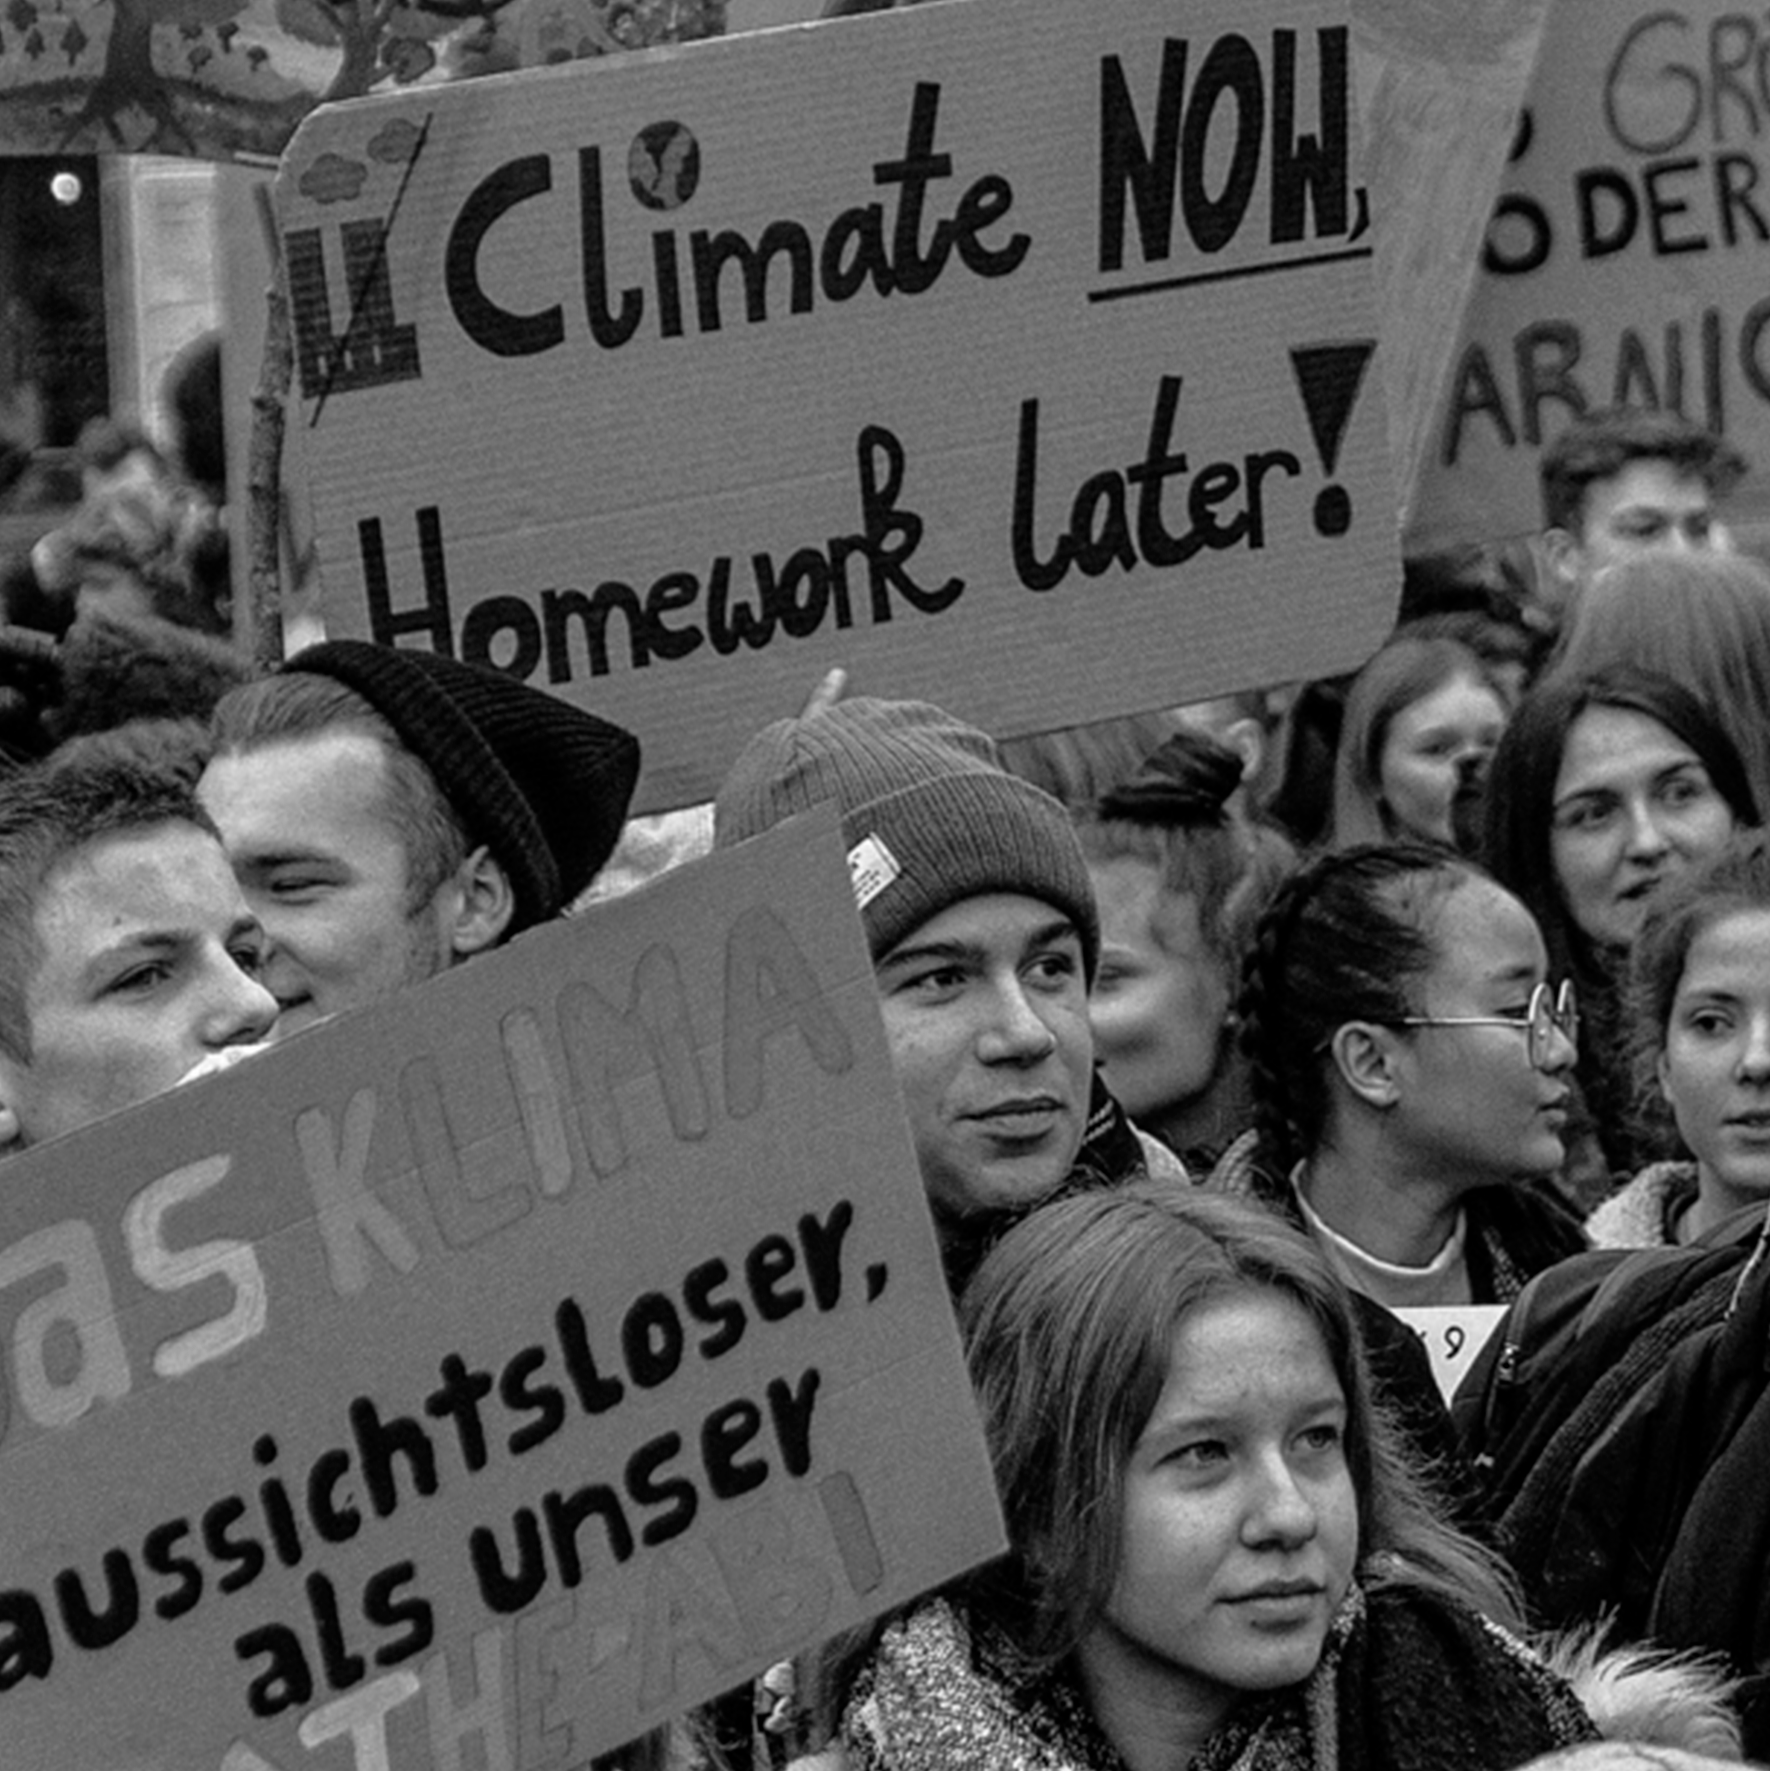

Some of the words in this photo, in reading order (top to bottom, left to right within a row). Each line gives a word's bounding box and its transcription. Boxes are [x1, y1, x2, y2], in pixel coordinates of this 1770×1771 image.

[445, 81, 1032, 357] Climate
[1099, 25, 1371, 272] NOW,
[1604, 9, 1770, 154] GR
[357, 423, 966, 684] Homework
[0, 1152, 267, 1427] as
[293, 904, 854, 1299] KLIMA
[0, 1199, 887, 1692] aussichtsloser,
[234, 1559, 434, 1718] als
[469, 1367, 820, 1615] unser
